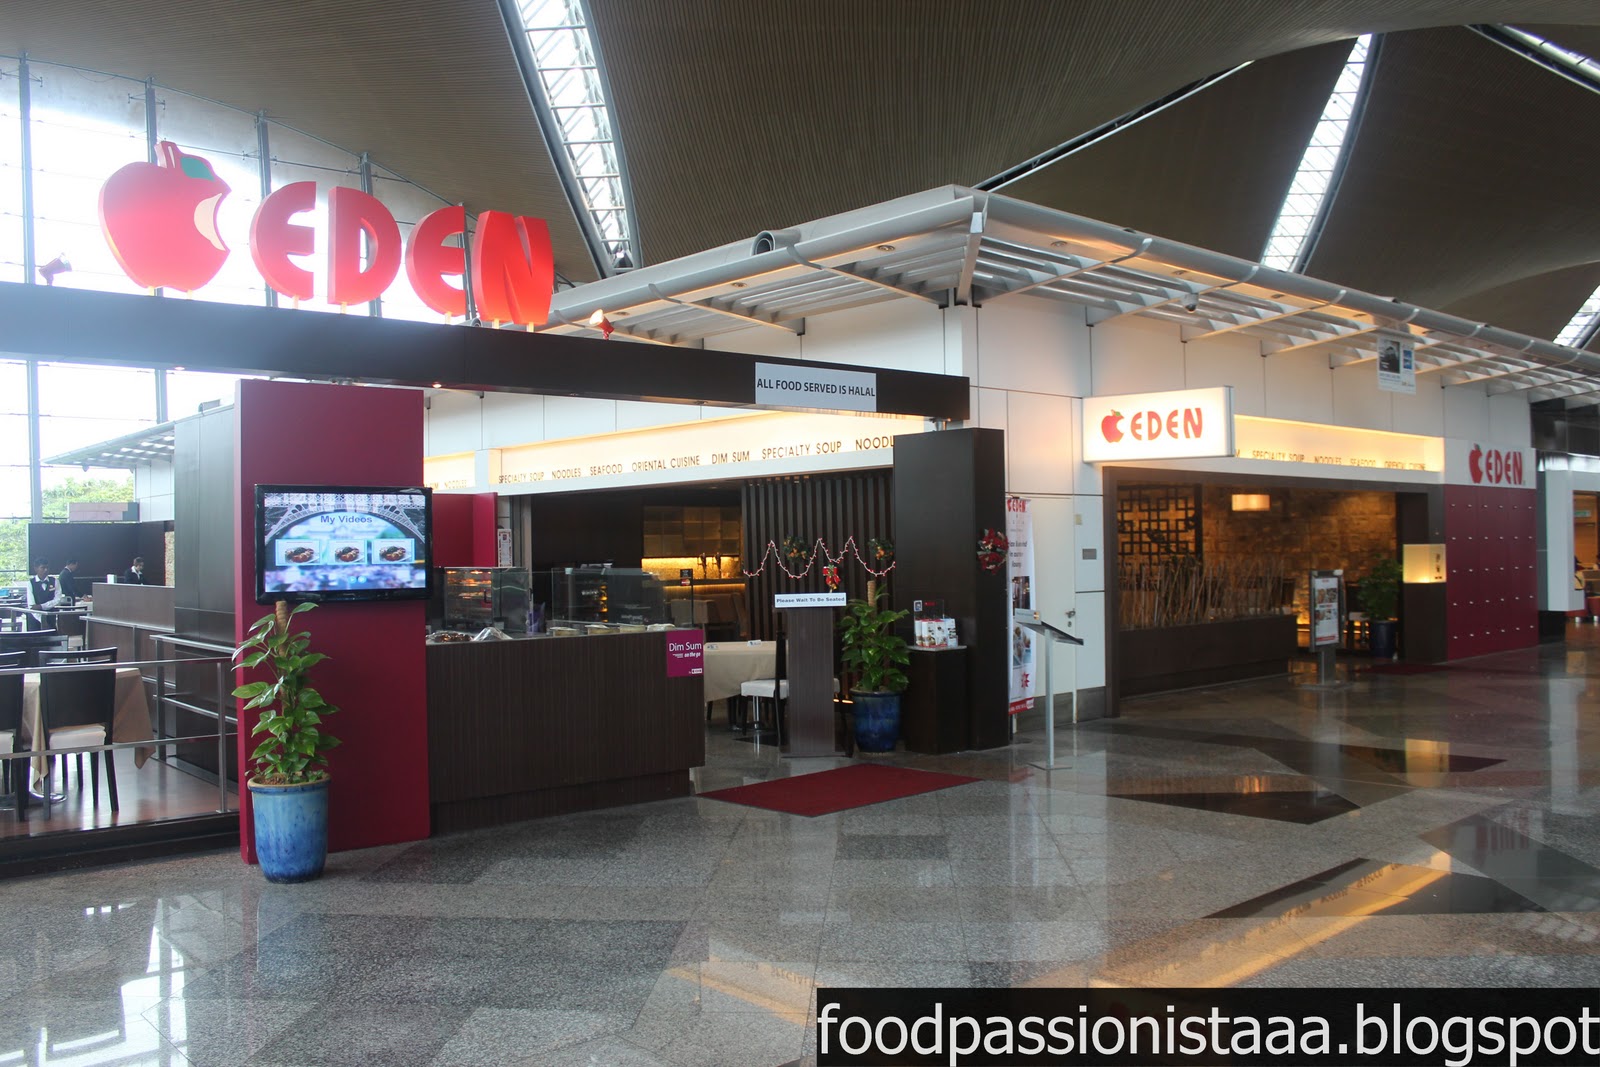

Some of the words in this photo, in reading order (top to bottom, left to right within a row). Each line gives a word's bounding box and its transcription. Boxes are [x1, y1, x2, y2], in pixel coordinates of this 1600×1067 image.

[250, 181, 555, 325] EDEN
[757, 378, 774, 389] ALL
[776, 380, 802, 391] FOOD
[804, 382, 837, 394] SERVED
[839, 385, 847, 395] IS
[849, 386, 875, 397] HALAL
[1130, 407, 1203, 441] EDEN
[499, 473, 527, 484] SPECIALTY
[529, 471, 545, 482] SOUP
[552, 467, 582, 479] NOODLES
[590, 463, 623, 476] SEAFOOD
[632, 459, 667, 472] ORIENTAL
[670, 454, 701, 468] CUISINE
[711, 453, 728, 465] DIM
[732, 450, 750, 463] SUM
[762, 443, 811, 460] SPECIALTY
[816, 441, 842, 455] SOUP
[855, 435, 894, 450] NOODL
[1485, 449, 1523, 485] EDEN
[320, 515, 335, 525] My
[339, 515, 372, 524] Videos
[669, 642, 685, 652] Dim
[685, 641, 702, 651] Sum
